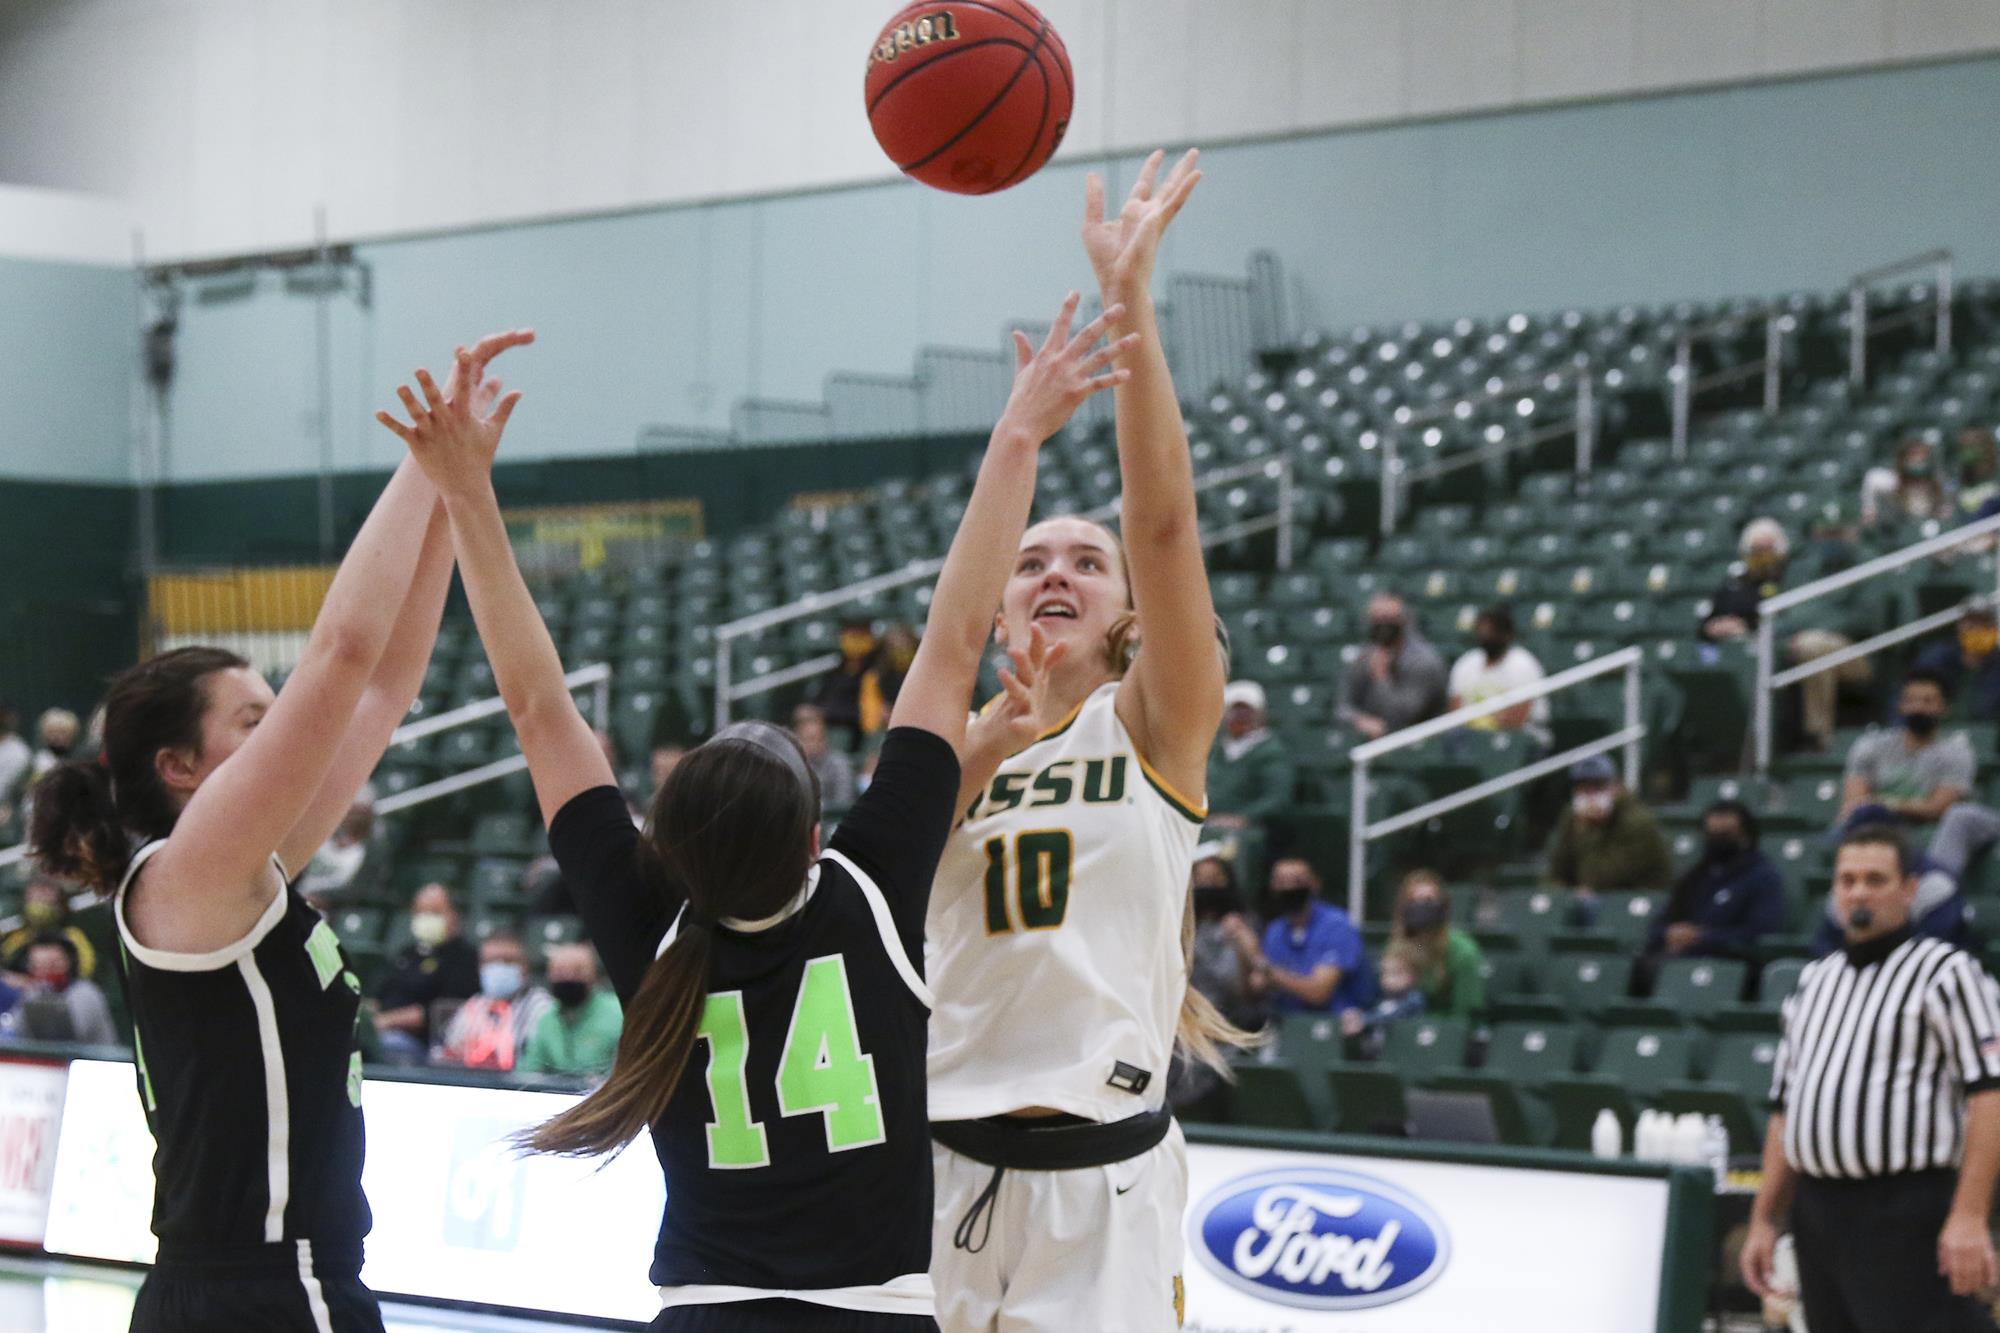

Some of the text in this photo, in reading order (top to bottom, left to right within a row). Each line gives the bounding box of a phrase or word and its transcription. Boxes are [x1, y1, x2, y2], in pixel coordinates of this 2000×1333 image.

[984, 828, 1074, 937] 10
[697, 953, 887, 1169] 14
[1233, 1184, 1399, 1291] Ford
